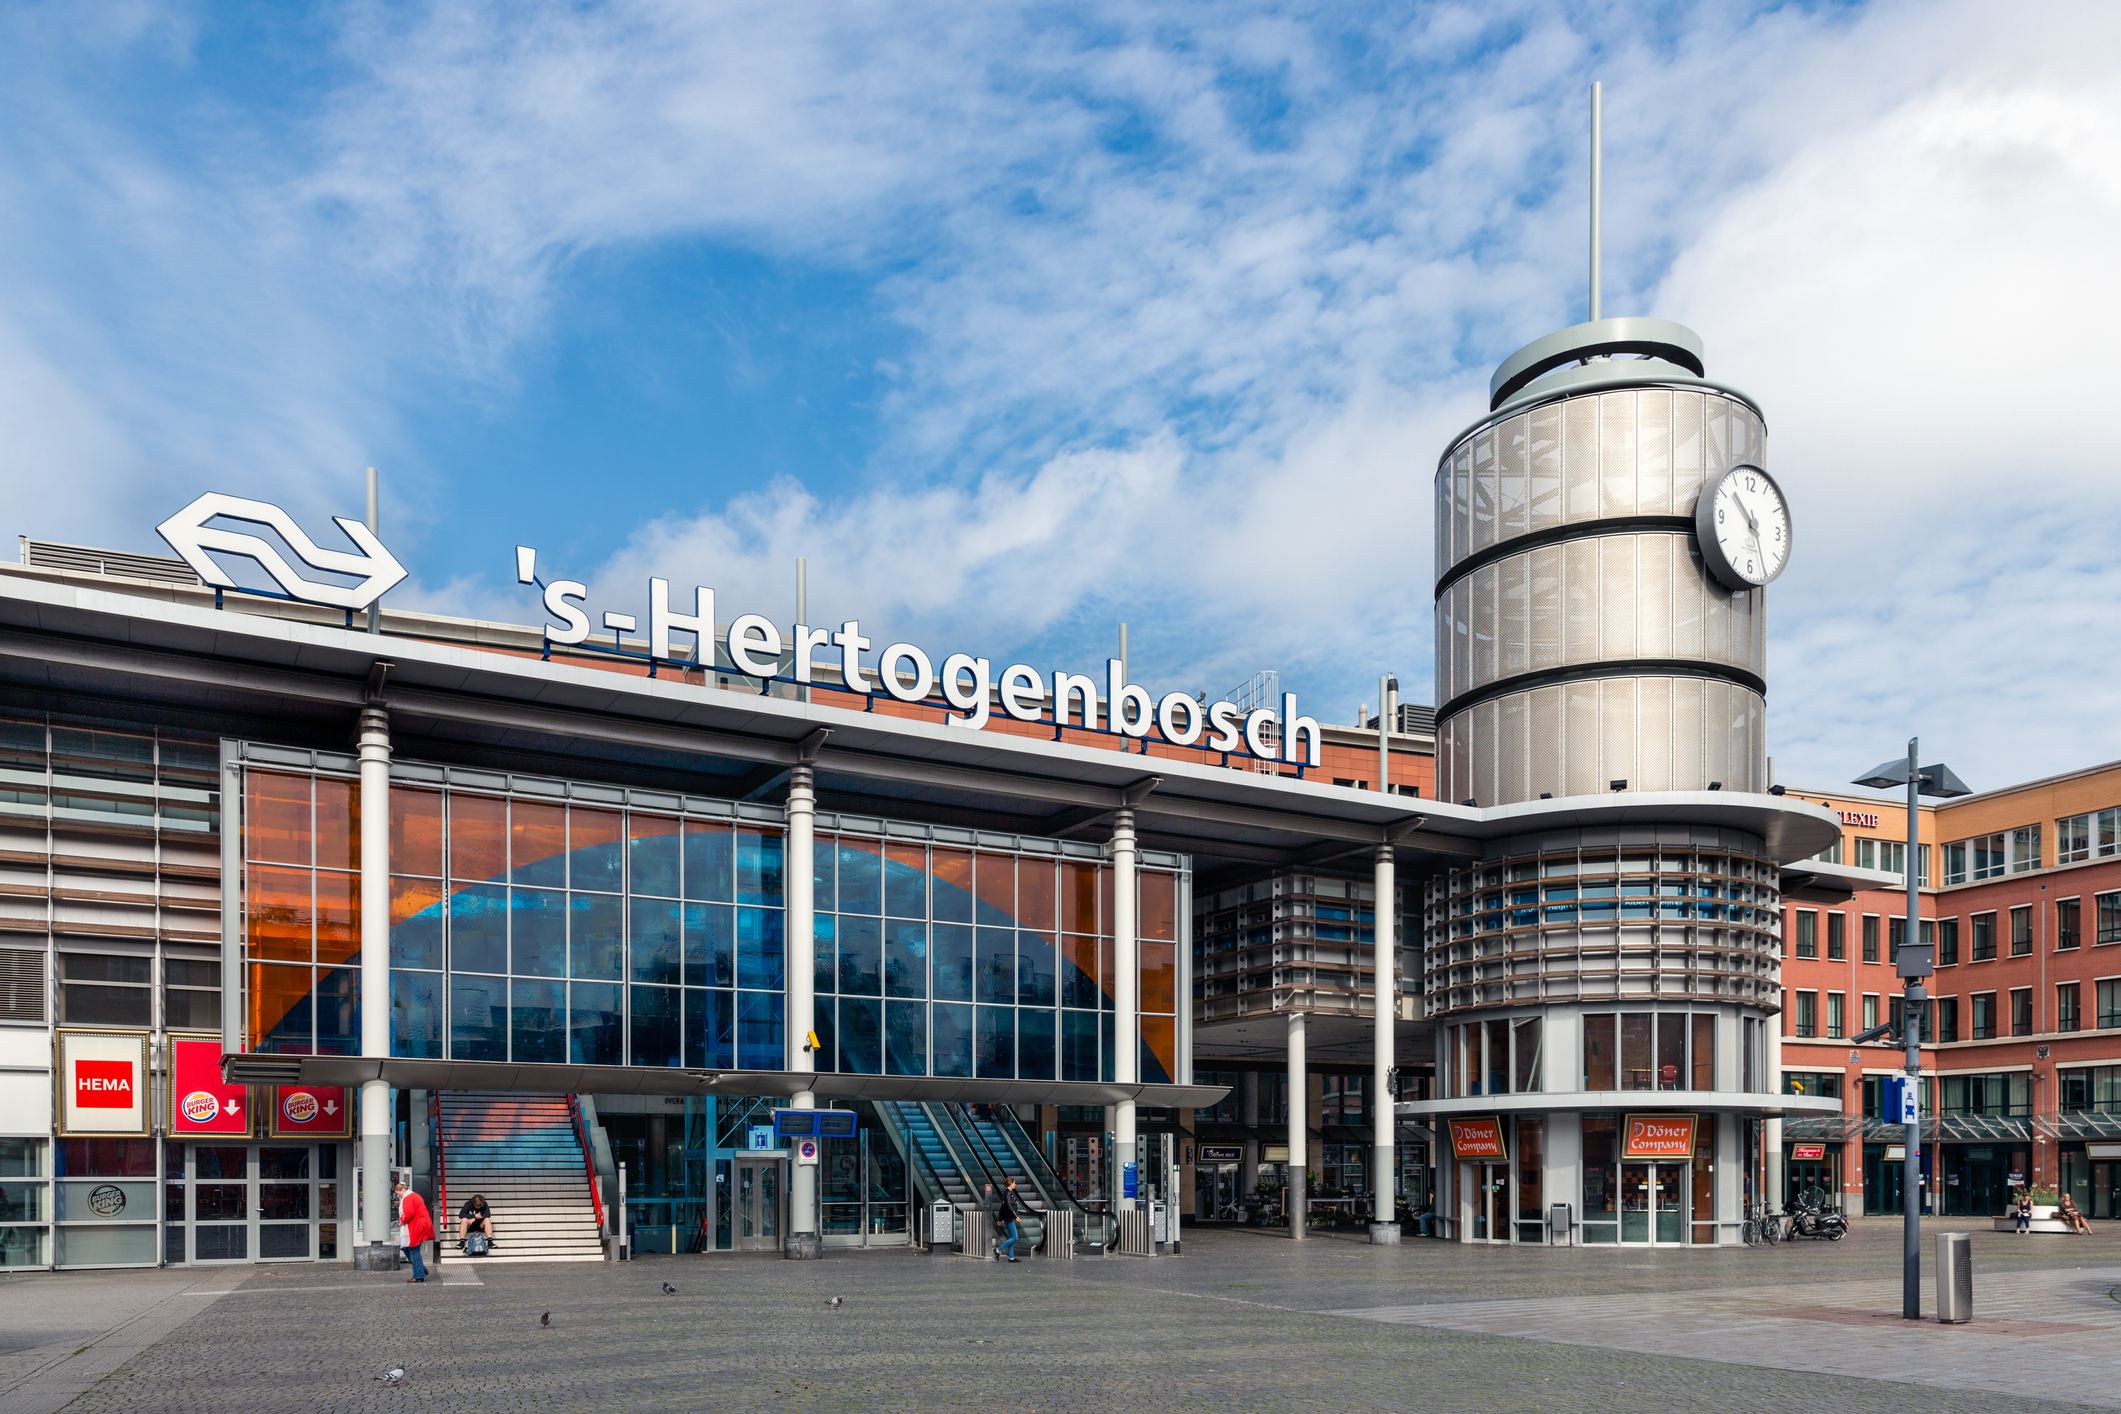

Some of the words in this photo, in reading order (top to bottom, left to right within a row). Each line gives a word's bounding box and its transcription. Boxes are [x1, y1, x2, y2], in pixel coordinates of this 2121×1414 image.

[1744, 476, 1756, 493] 12
[1718, 509, 1725, 524] 9
[1774, 526, 1781, 542] 3
[1746, 559, 1753, 574] 6
[515, 544, 1321, 767] 's-Hertogenbosch
[1834, 810, 1880, 827] SLEXIE
[78, 1078, 131, 1091] HEMA
[186, 1096, 214, 1109] BURGER
[187, 1103, 215, 1116] KING
[287, 1098, 314, 1110] BURGER
[288, 1103, 315, 1116] KING
[1464, 1127, 1494, 1140] Döner
[1647, 1124, 1688, 1137] Döner
[1457, 1139, 1498, 1153] Company
[1631, 1138, 1687, 1152] Company
[92, 1190, 121, 1202] BURGER
[93, 1196, 123, 1211] KING
